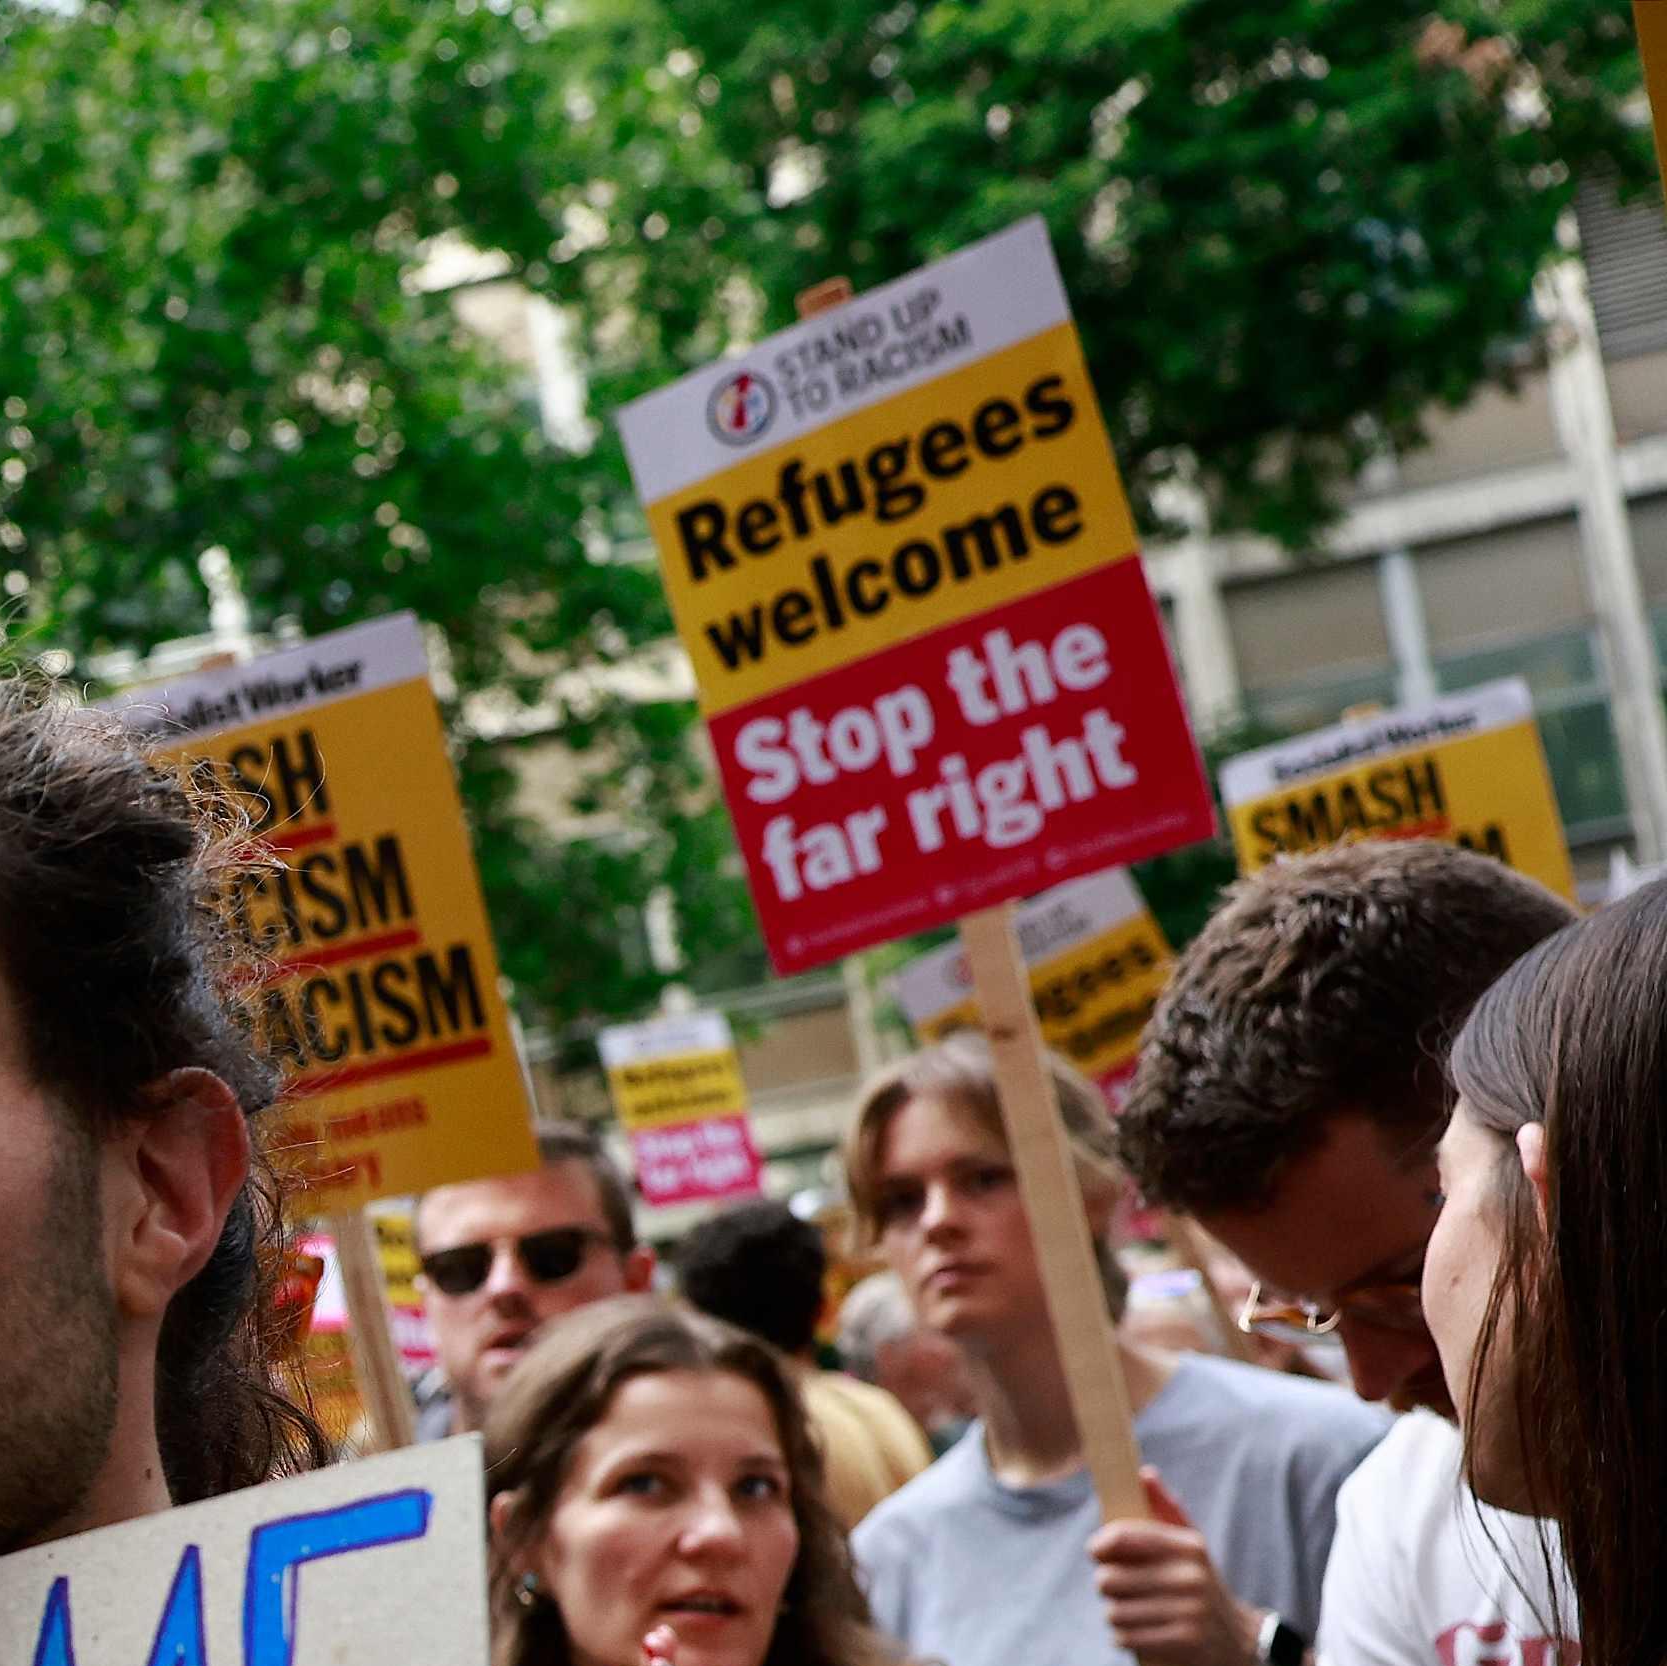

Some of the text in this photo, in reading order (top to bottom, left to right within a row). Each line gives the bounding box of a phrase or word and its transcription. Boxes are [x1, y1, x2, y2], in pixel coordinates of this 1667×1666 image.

[774, 288, 942, 379] STAND UP
[789, 317, 975, 421] TO RACISM
[677, 374, 1079, 582] Refugees
[704, 483, 1085, 671] welcome
[734, 623, 1111, 804] Stop the
[762, 806, 888, 902] far
[908, 708, 1138, 850] right
[1250, 757, 1447, 852] SMASH
